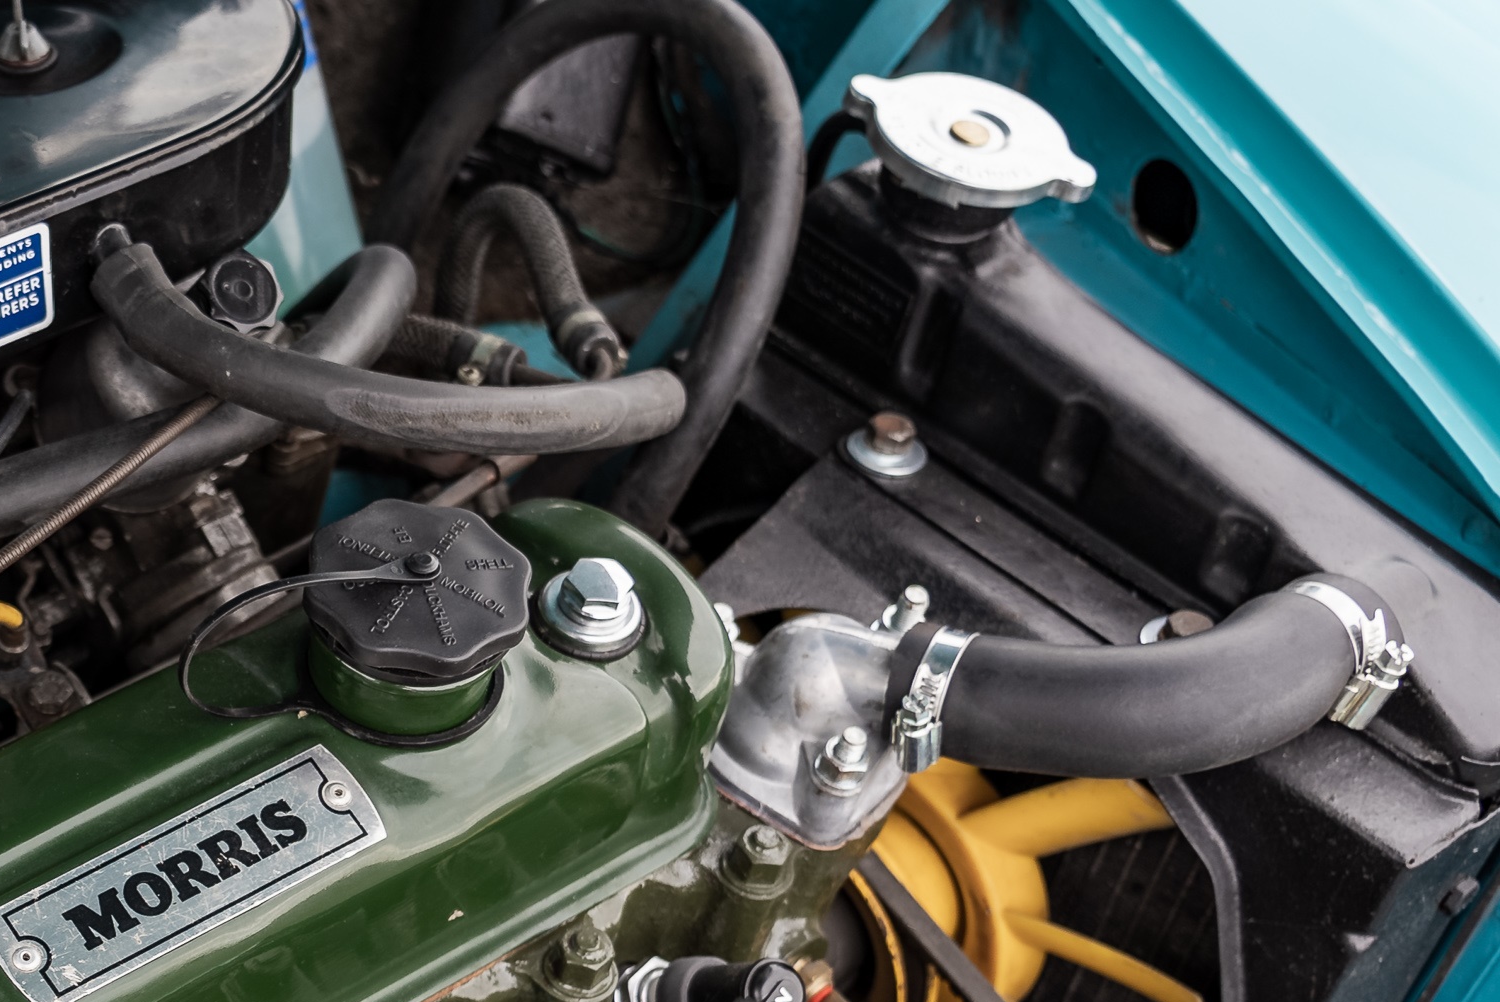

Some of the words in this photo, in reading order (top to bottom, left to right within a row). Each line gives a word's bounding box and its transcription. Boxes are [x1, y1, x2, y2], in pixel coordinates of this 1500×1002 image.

[465, 559, 514, 571] SHELL
[441, 576, 506, 618] MOBILOIL
[62, 799, 308, 951] MORRIS
